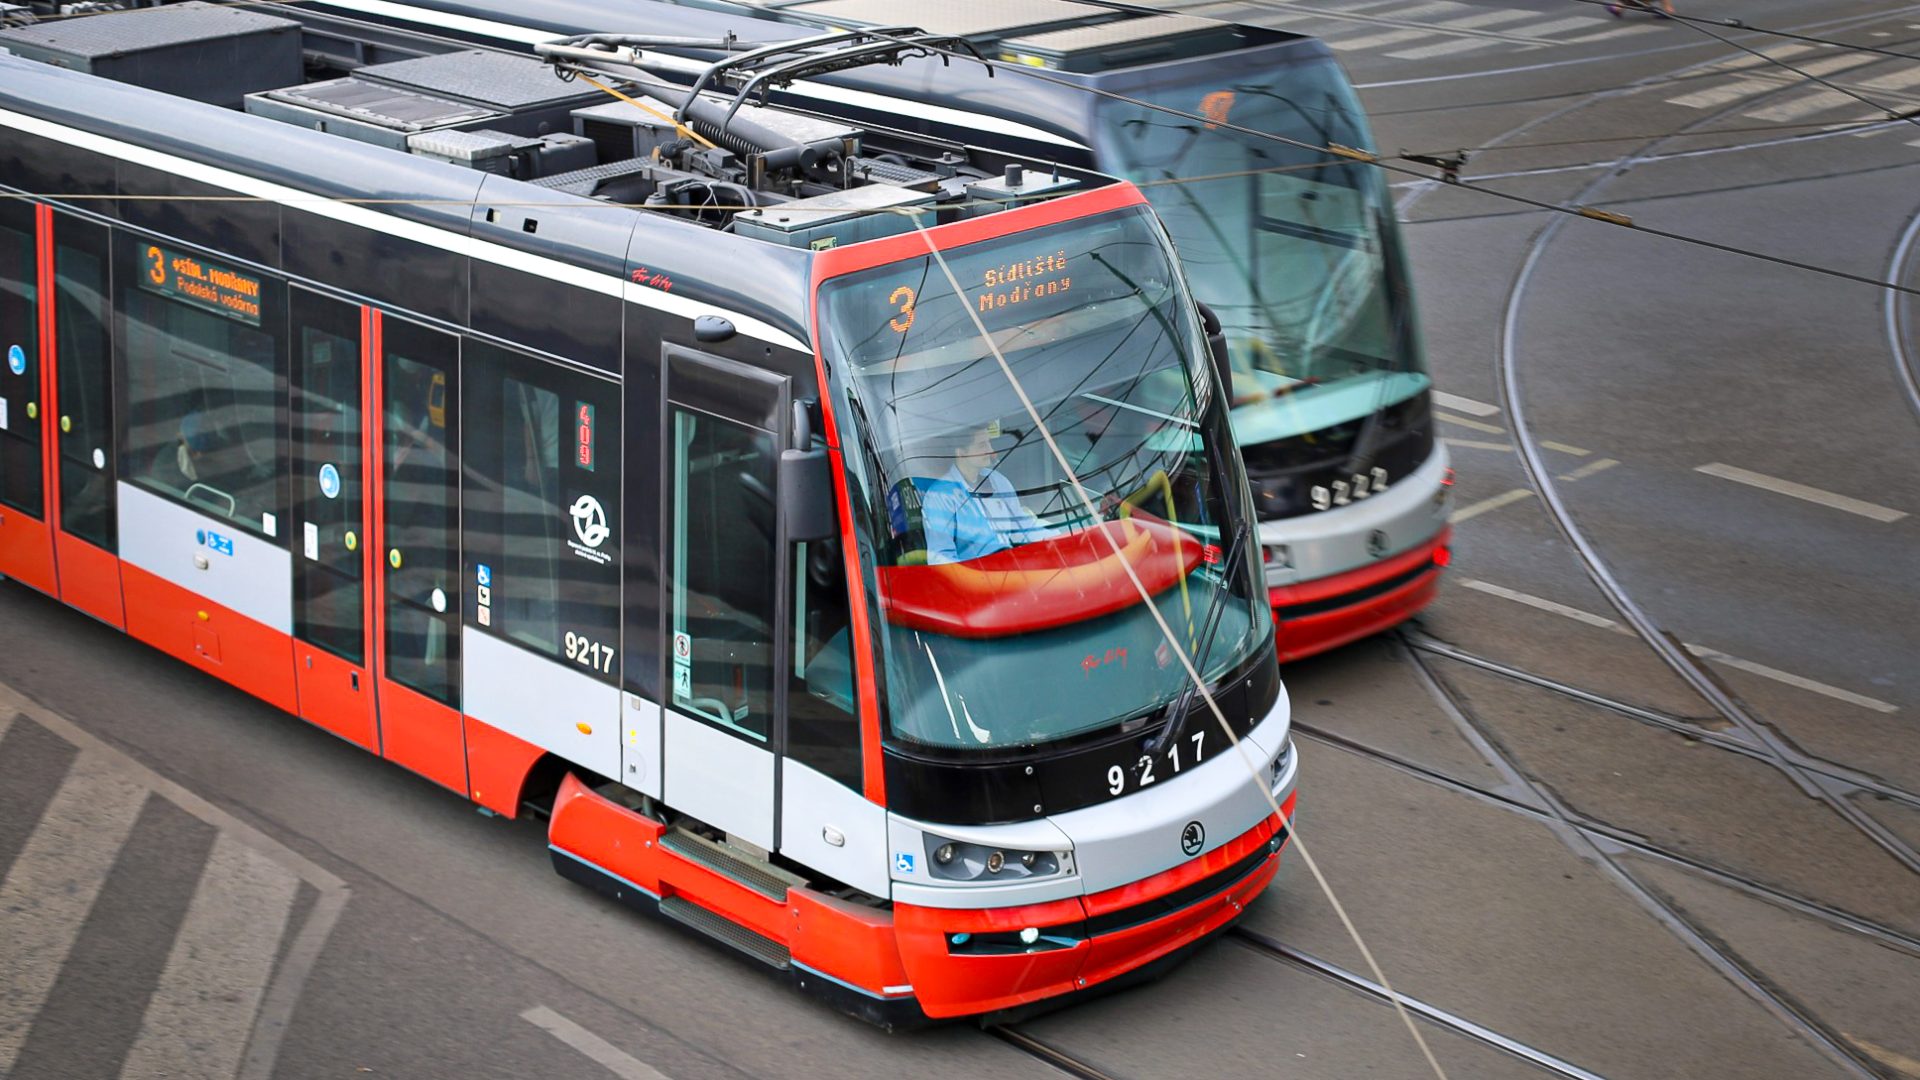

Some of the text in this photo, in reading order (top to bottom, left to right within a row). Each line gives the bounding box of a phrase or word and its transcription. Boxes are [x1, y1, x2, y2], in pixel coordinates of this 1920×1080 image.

[148, 246, 166, 285] 3
[985, 249, 1066, 288] Sídliště
[889, 286, 915, 333] 3
[979, 277, 1071, 312] Modřany
[1310, 466, 1390, 511] 9222
[564, 631, 615, 674] 9217
[1107, 731, 1206, 796] 9217
